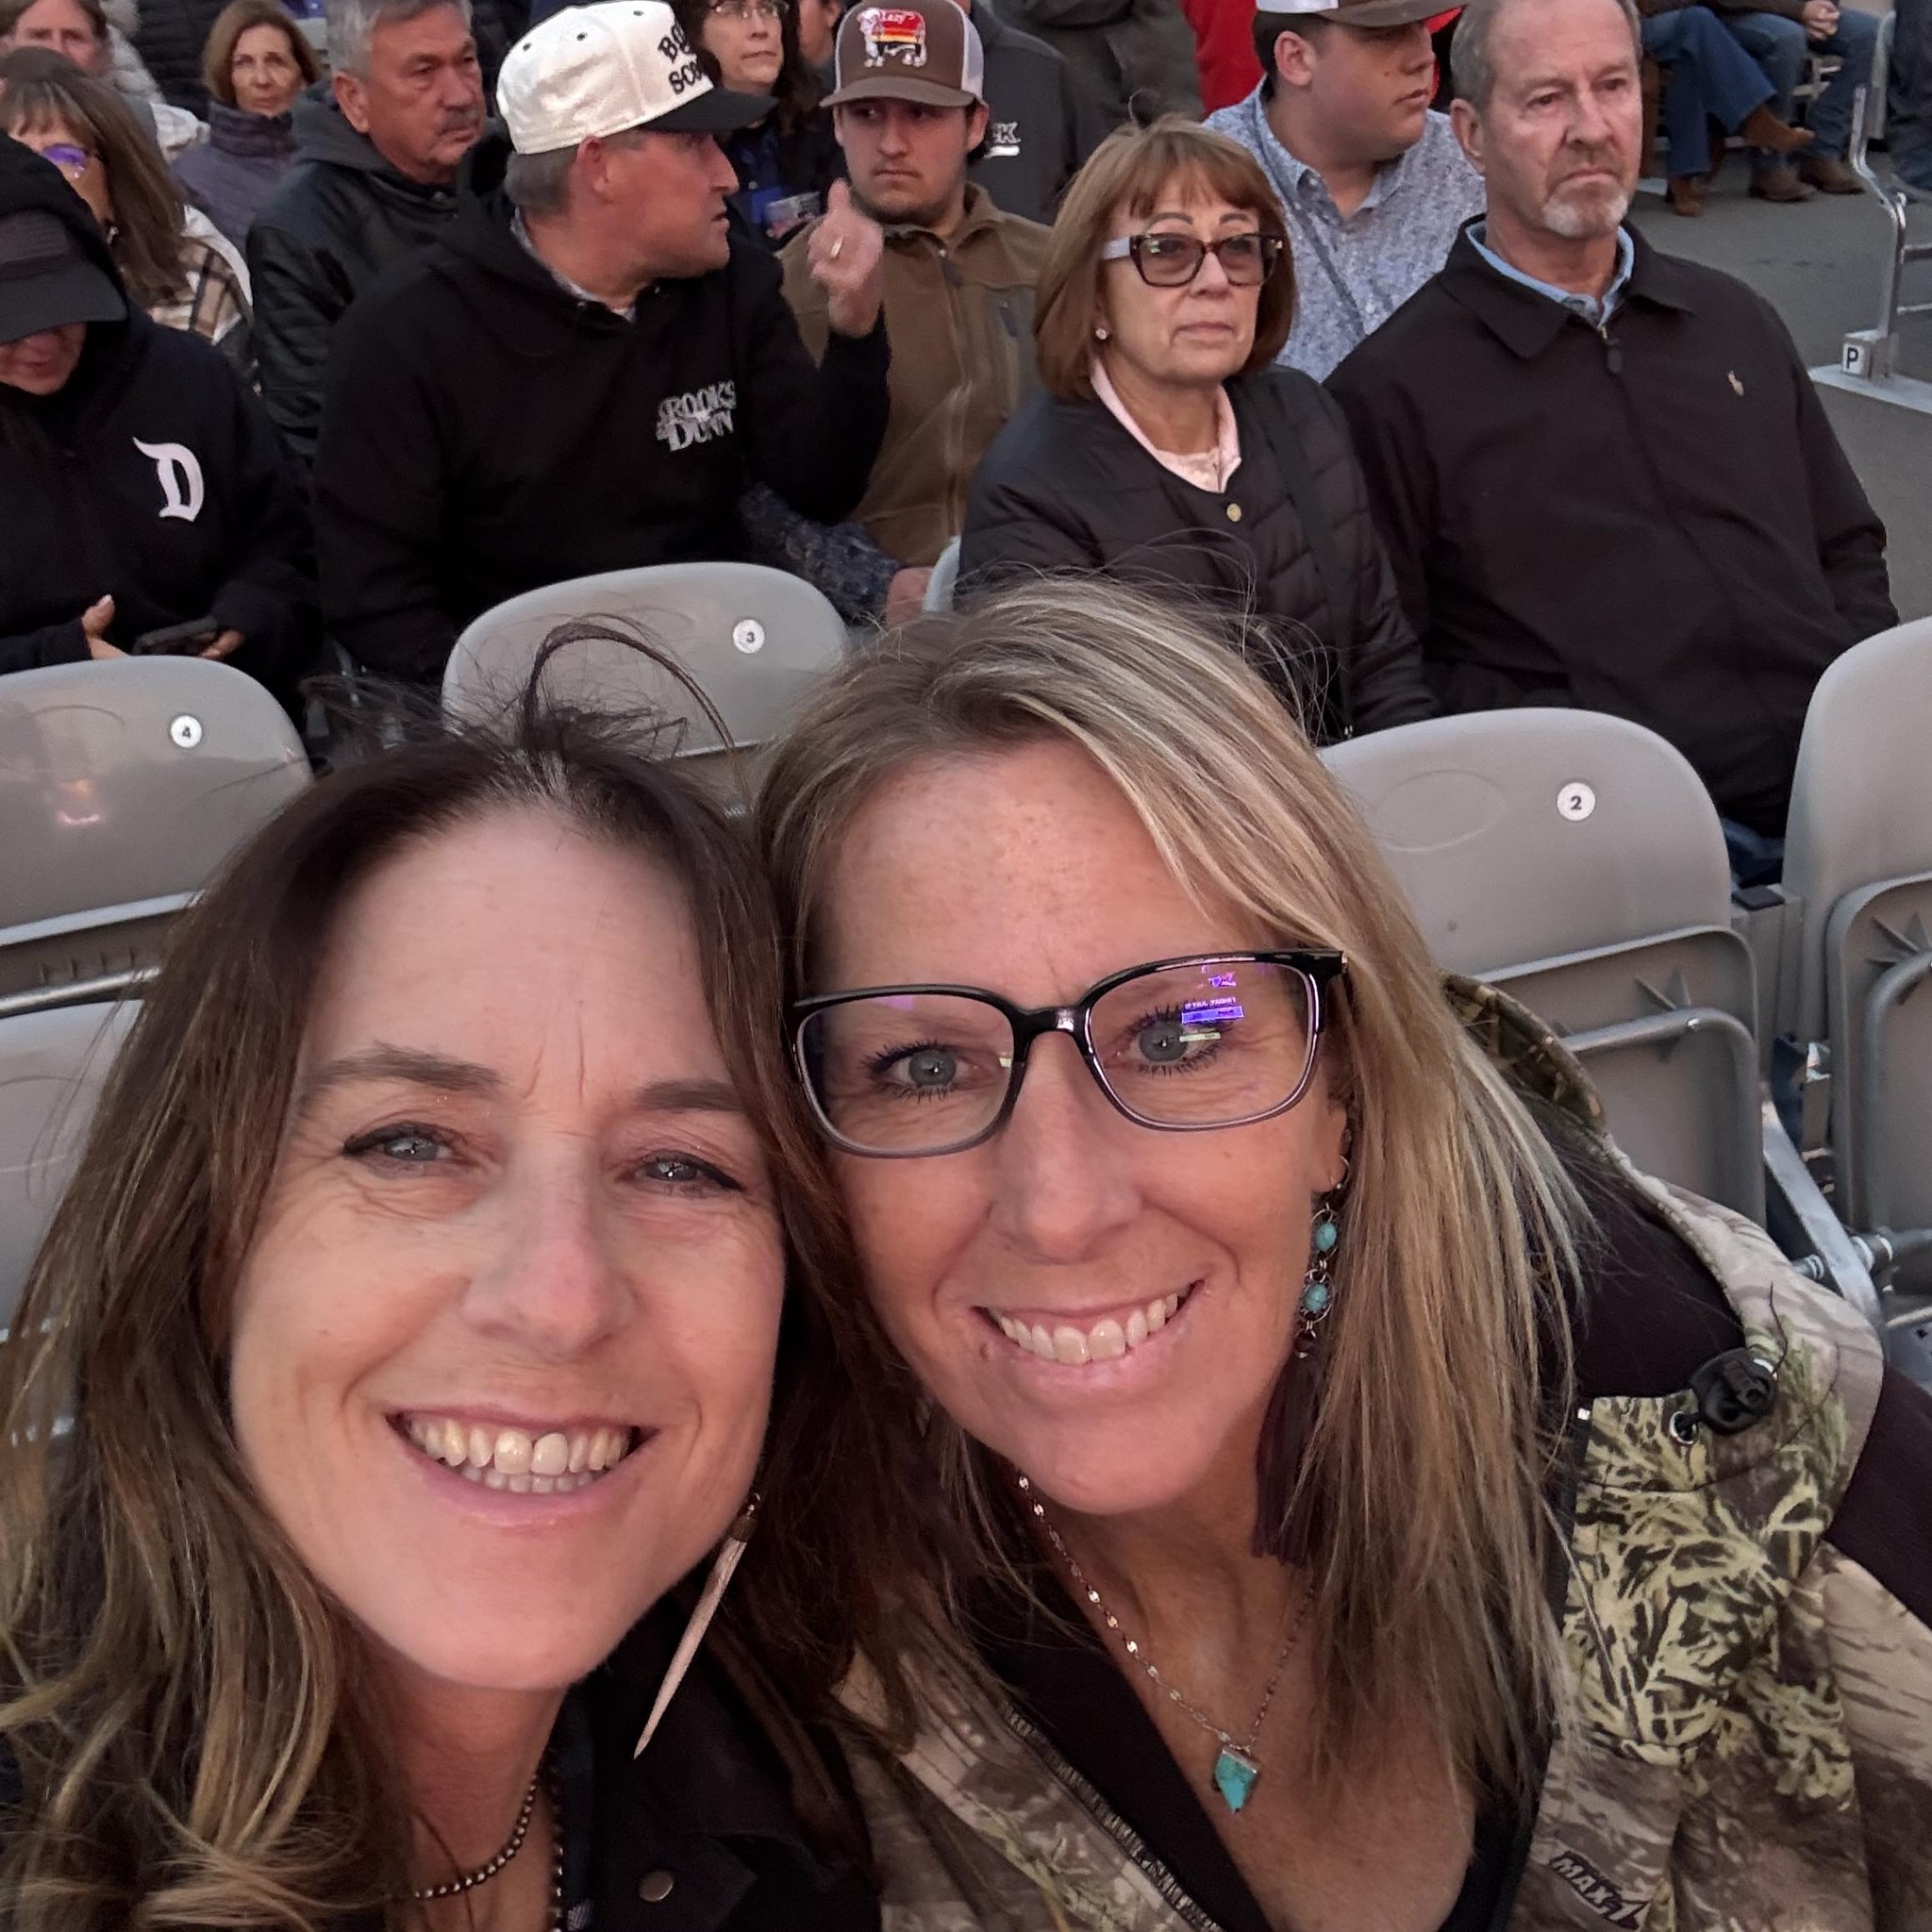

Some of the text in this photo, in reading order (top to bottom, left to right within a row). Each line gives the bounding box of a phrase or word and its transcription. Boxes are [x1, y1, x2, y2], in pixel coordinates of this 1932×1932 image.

[1846, 346, 1858, 369] P
[133, 437, 205, 522] D
[1570, 795, 1583, 810] 2
